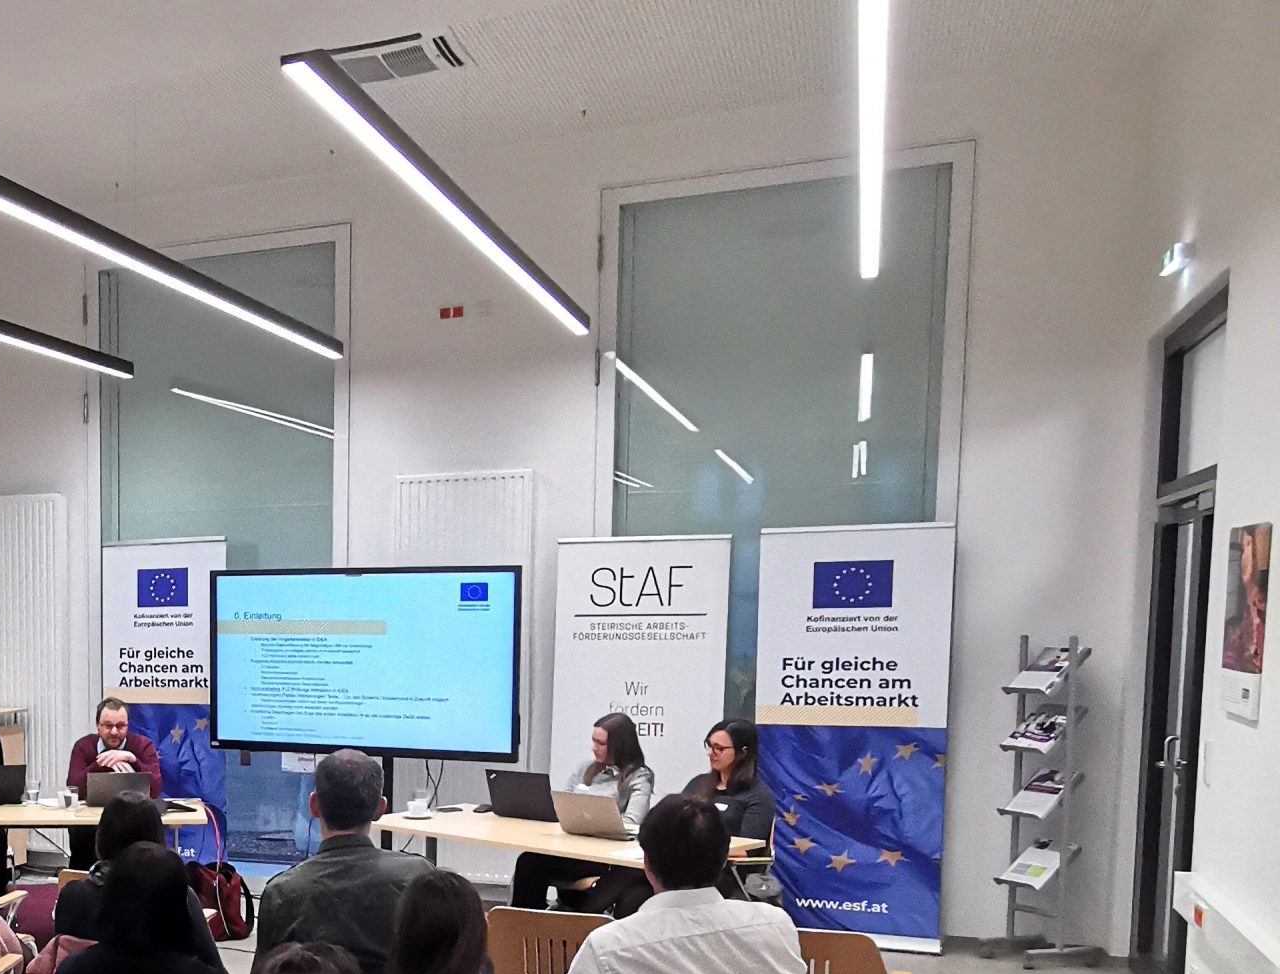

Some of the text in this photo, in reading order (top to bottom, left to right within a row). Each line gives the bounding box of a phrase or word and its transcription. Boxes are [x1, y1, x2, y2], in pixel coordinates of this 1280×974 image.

[590, 566, 693, 607] StAF
[243, 611, 282, 622] Einleitung
[883, 614, 898, 622] der
[590, 622, 689, 631] STEIRISCHE ARBEITS-
[806, 625, 868, 633] Europäischen
[119, 647, 194, 661] Für gleiche
[119, 662, 203, 673] Chancen am
[782, 656, 898, 674] Für gleiche
[119, 676, 209, 688] Arbeitsmarkt
[625, 681, 649, 696] Wir
[781, 675, 912, 689] Chancen am
[780, 692, 919, 707] Arbeitsmarkt
[796, 897, 888, 914] www.esf.at
